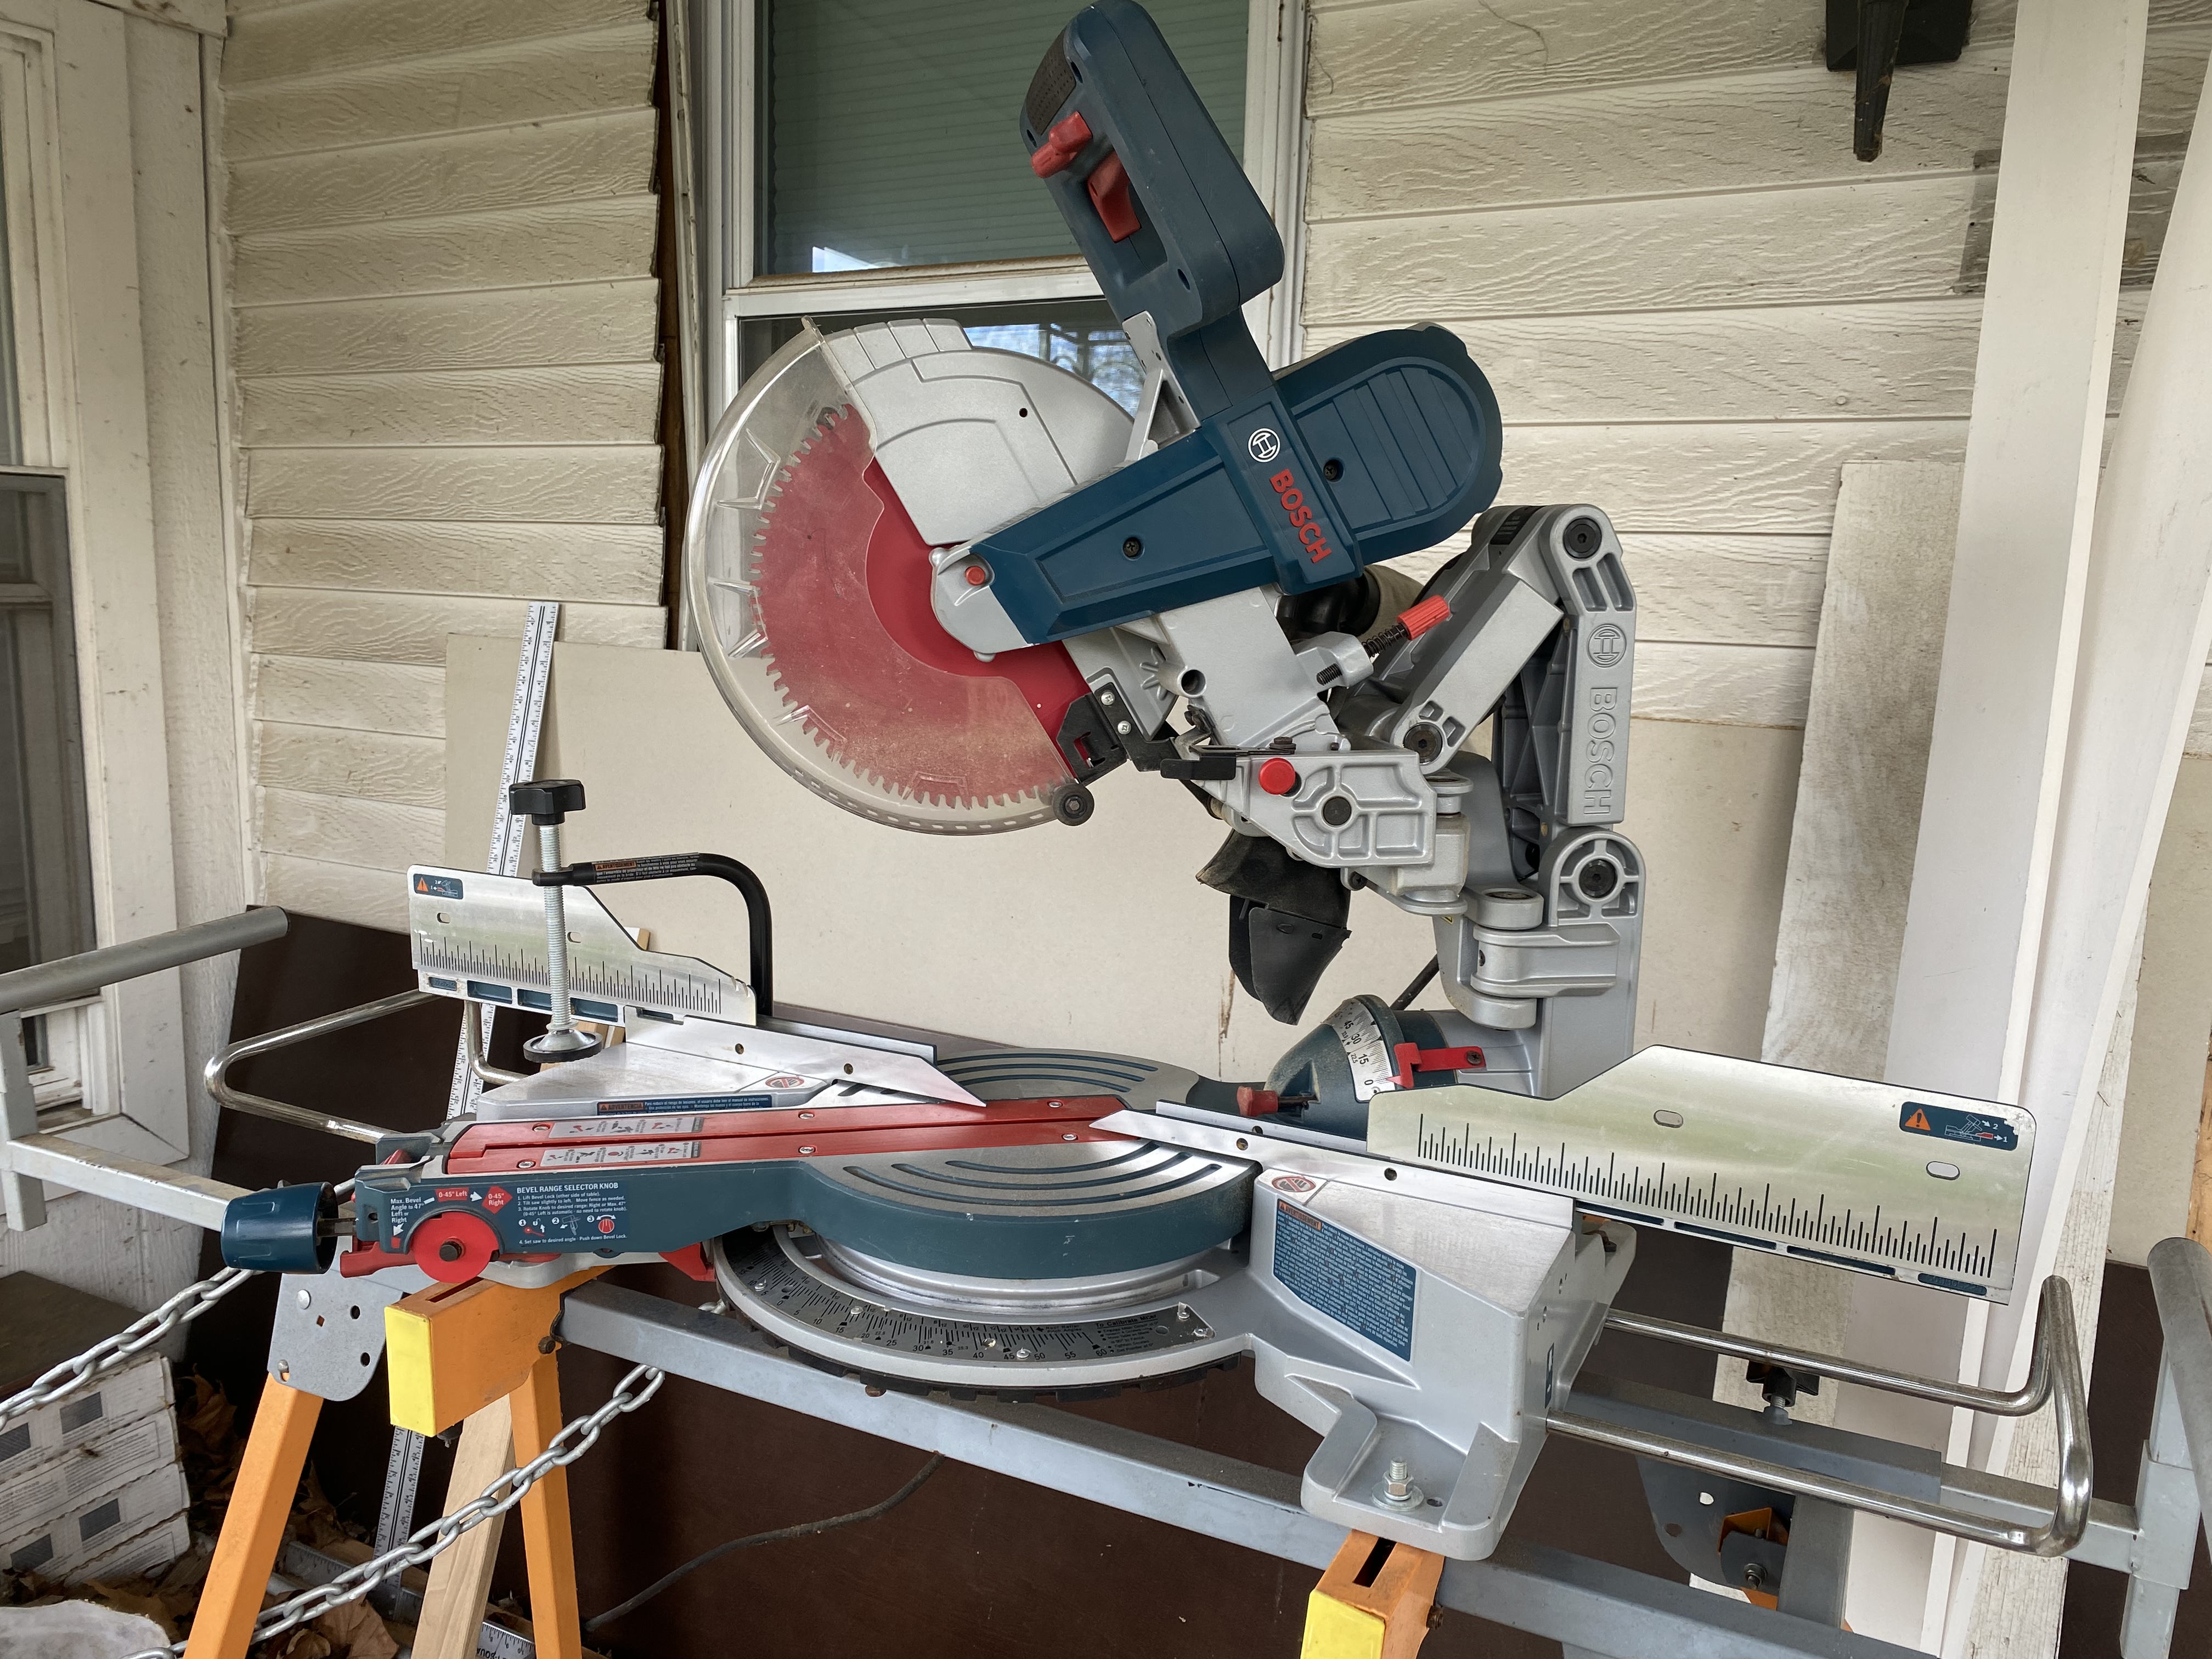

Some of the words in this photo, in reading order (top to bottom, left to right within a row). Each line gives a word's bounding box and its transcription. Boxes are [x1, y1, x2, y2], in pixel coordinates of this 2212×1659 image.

[1270, 468, 1333, 565] BOSCH
[1584, 688, 1617, 816] BOSCH
[1344, 1019, 1354, 1030] 45
[1351, 1034, 1362, 1045] 30
[1358, 1054, 1369, 1065] 15
[608, 1103, 644, 1111] ADVERTENCIA
[1285, 1206, 1319, 1229] AVERTISSEMENT
[1107, 1318, 1138, 1327] Calibrate
[1096, 1348, 1108, 1357] 60
